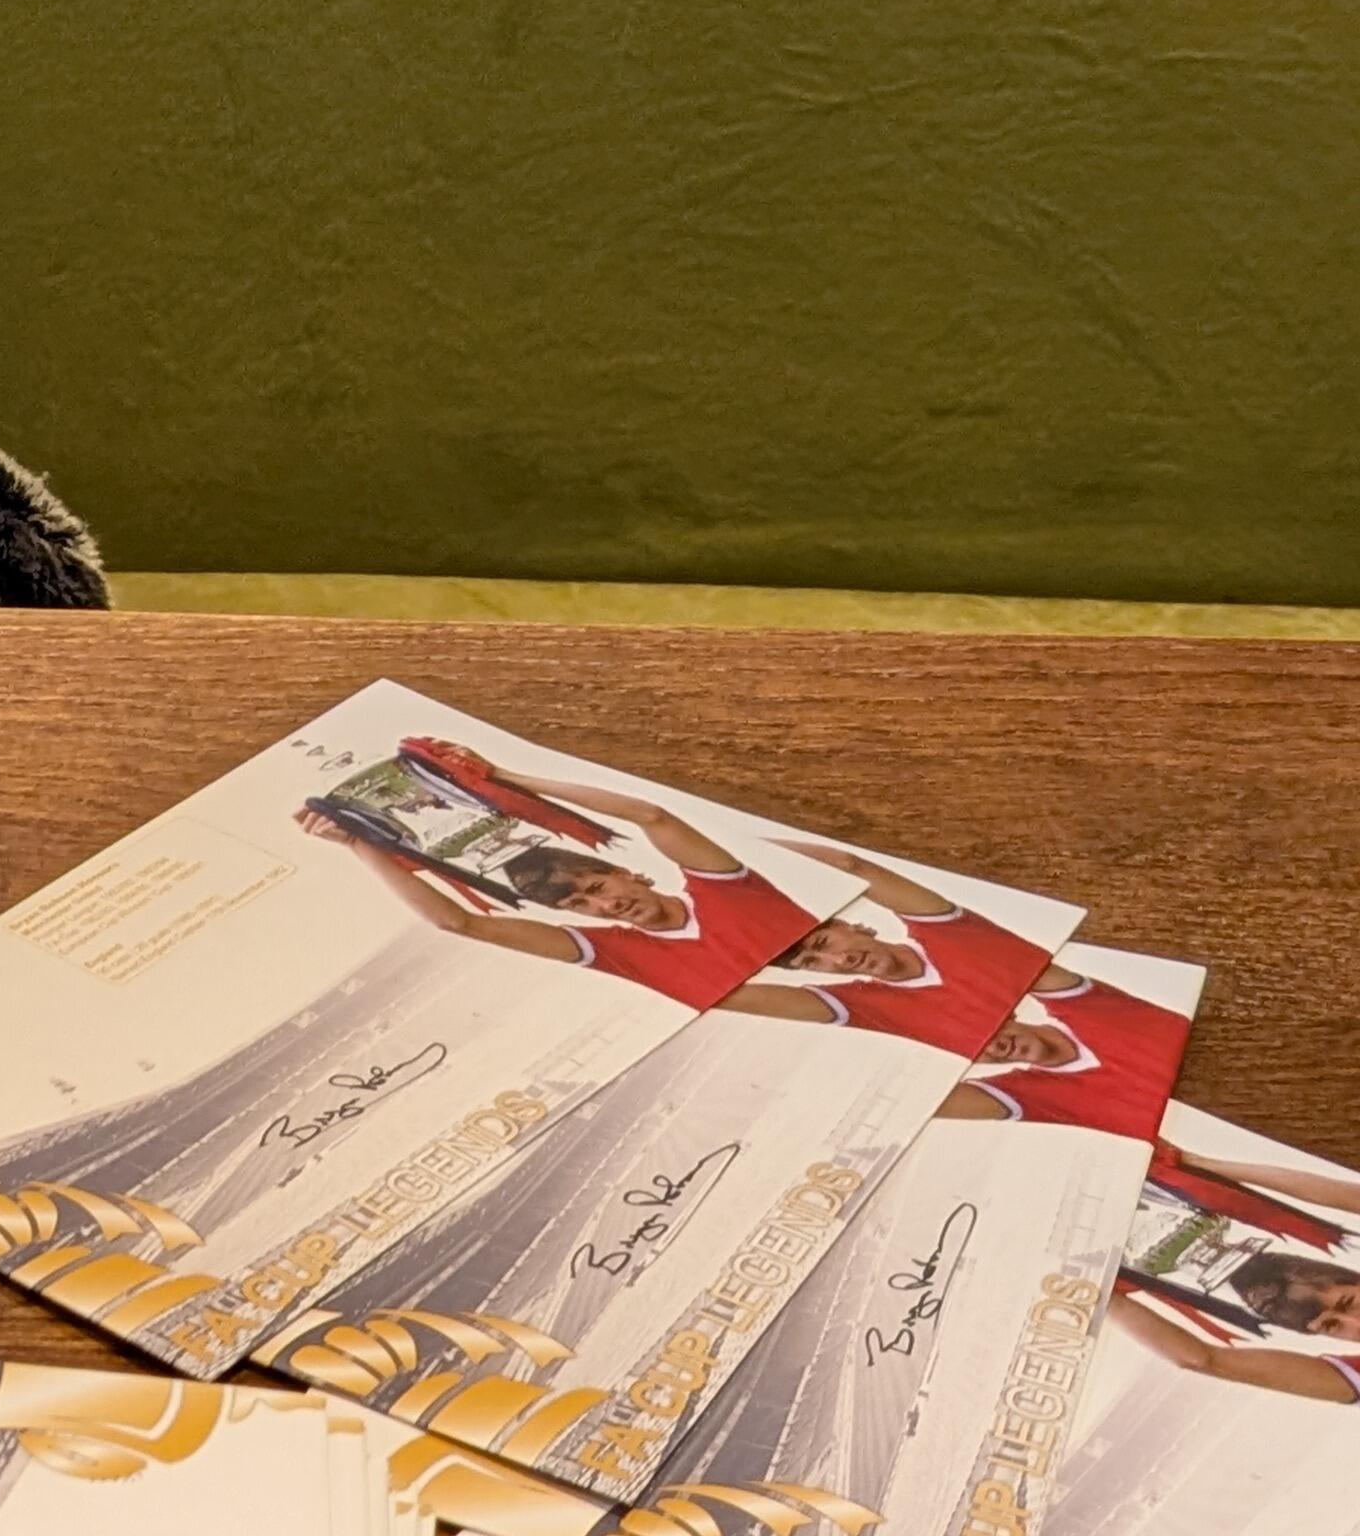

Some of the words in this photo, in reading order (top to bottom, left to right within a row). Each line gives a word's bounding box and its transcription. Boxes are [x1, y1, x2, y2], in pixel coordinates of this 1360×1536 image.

[168, 1306, 260, 1364] FA
[239, 1231, 342, 1310] CUP
[336, 1089, 549, 1241] LEGENDS
[578, 1422, 664, 1481] FA
[629, 1329, 721, 1418] CUP
[701, 1160, 865, 1336] LEGENDS
[986, 1271, 1102, 1478] LEGENDS
